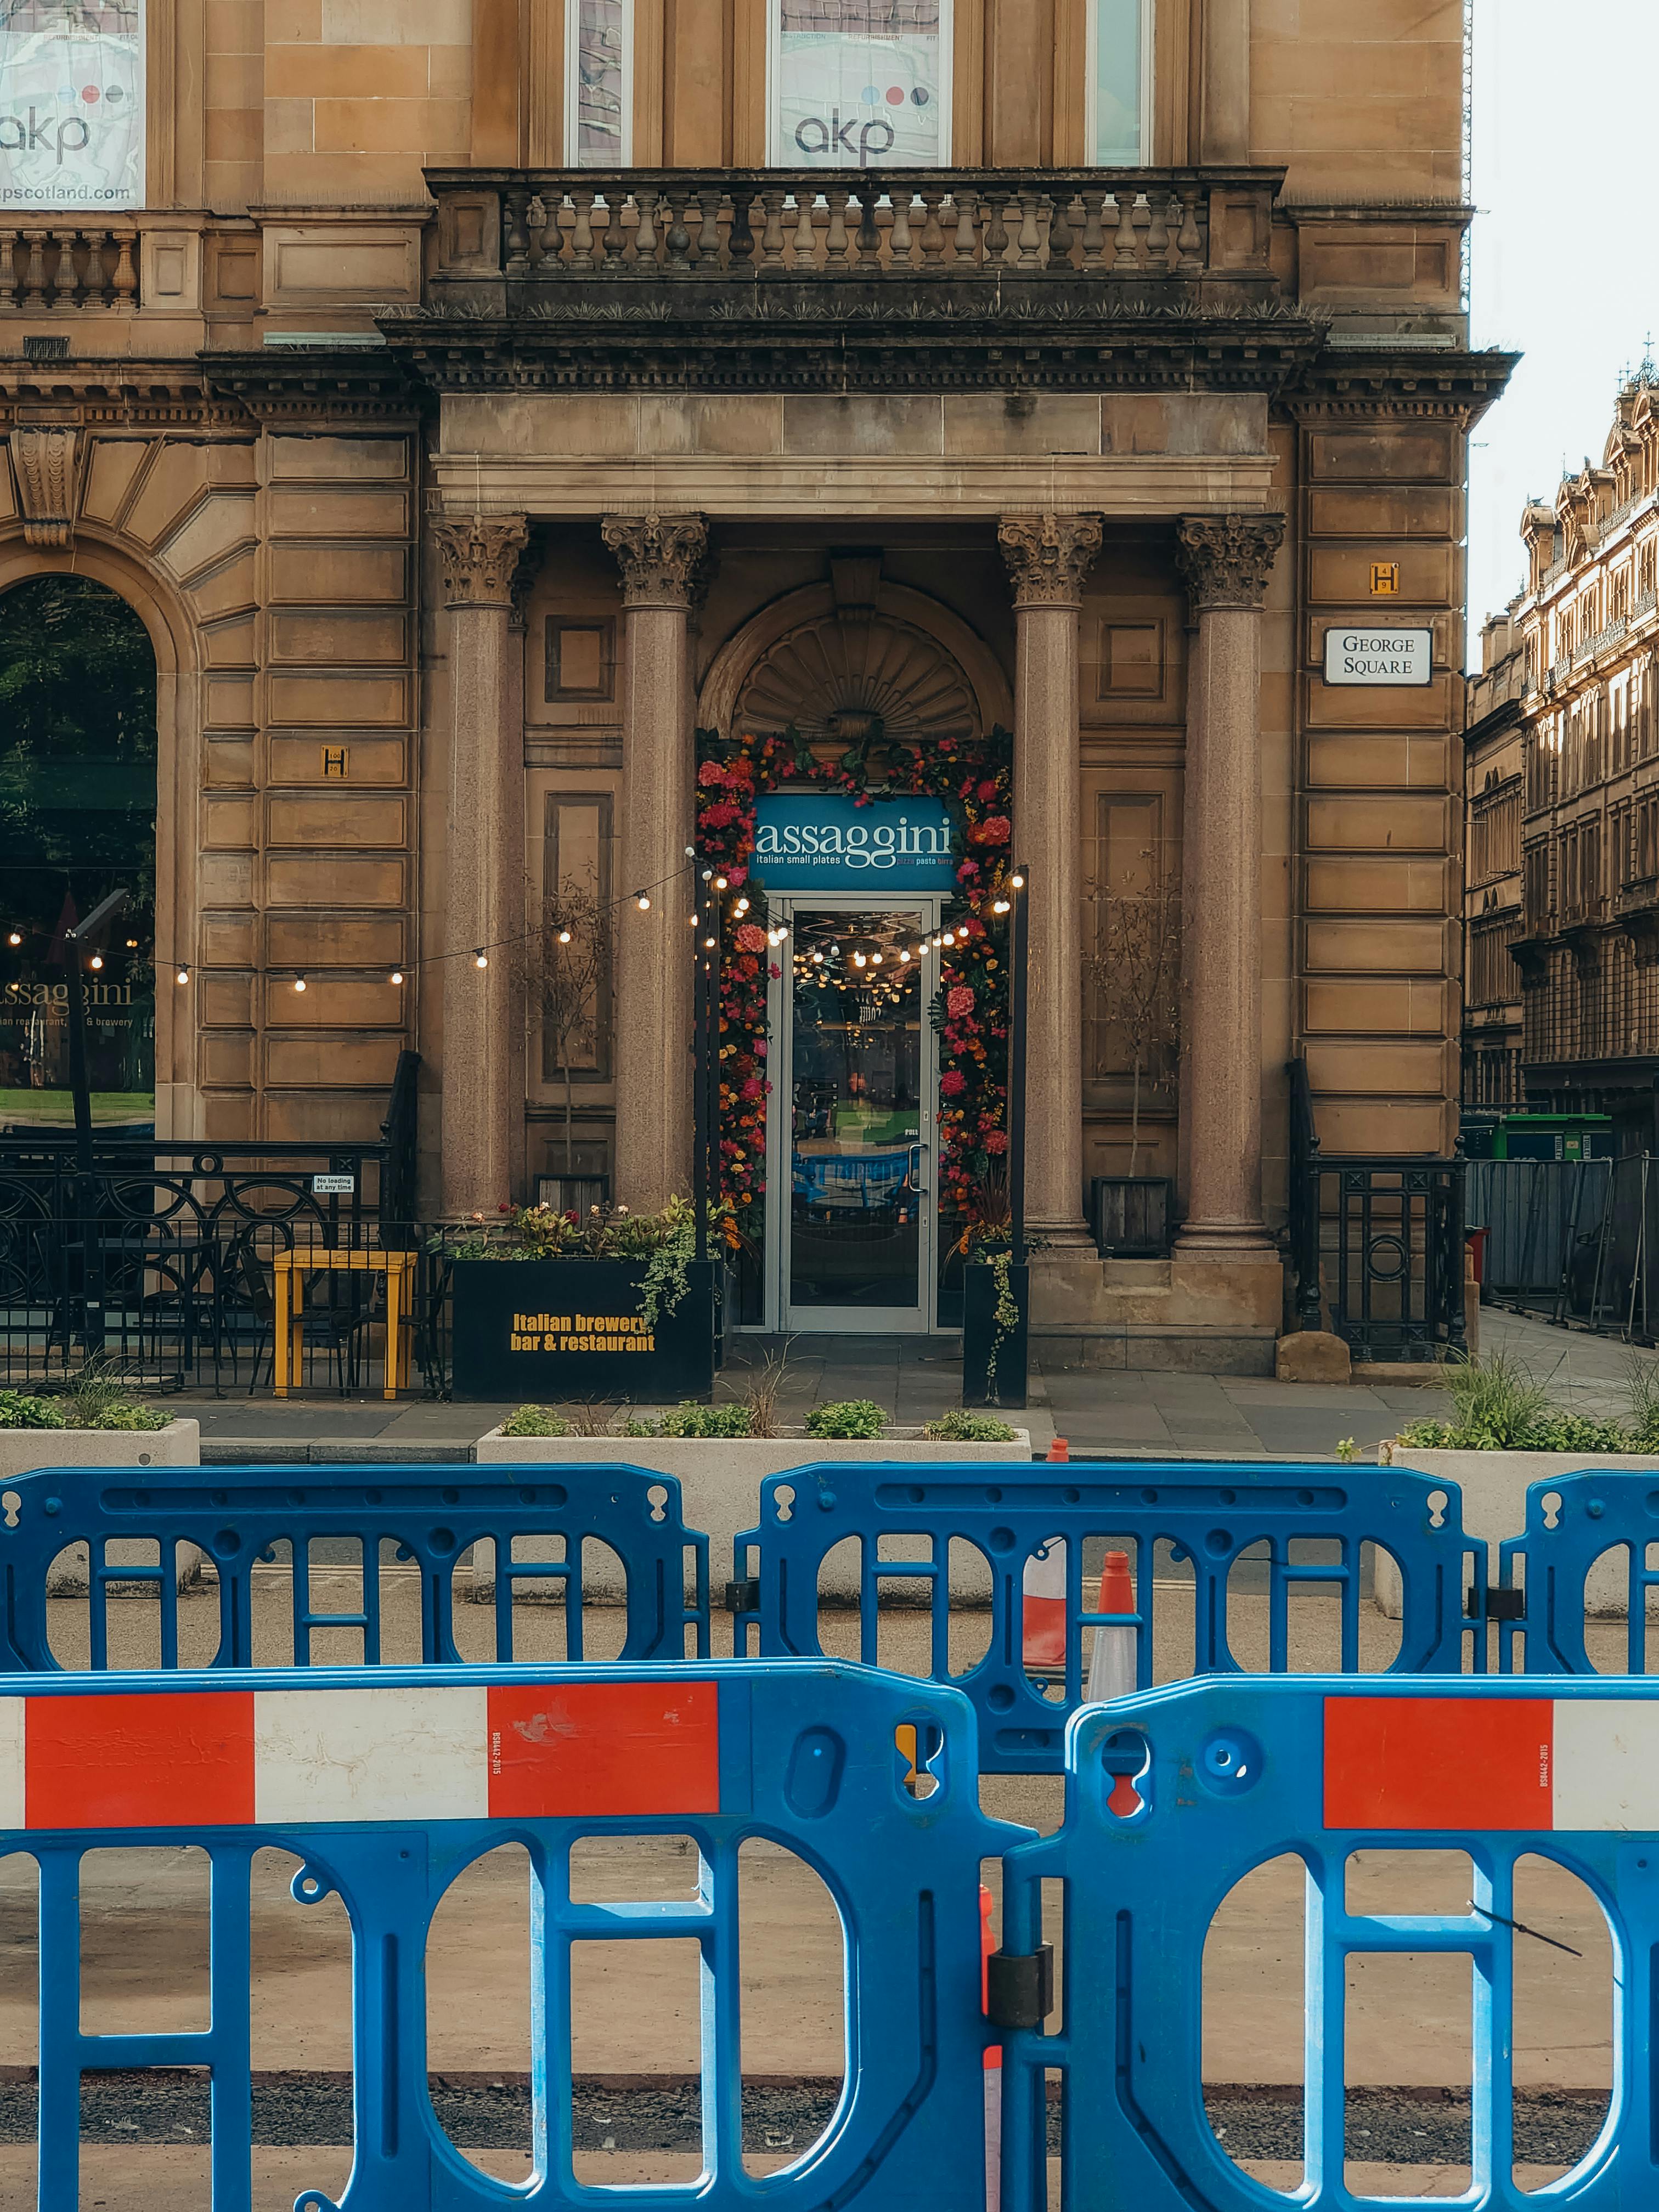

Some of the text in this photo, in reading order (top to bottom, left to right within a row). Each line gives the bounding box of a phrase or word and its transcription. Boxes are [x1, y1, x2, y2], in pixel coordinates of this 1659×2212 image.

[0, 106, 91, 165] akp
[795, 108, 895, 167] akp
[0, 185, 129, 202] pscotland.com
[1374, 566, 1394, 591] H
[1343, 636, 1415, 652] GEORGE
[1344, 657, 1413, 676] SQUARE
[325, 749, 345, 775] H
[756, 817, 951, 868] assaggini
[757, 855, 840, 866] italian small plates
[15, 1018, 67, 1027] resaurant,
[87, 1018, 93, 1026] &
[96, 1018, 133, 1028] brewery
[514, 1314, 571, 1331] Italian
[511, 1334, 655, 1351] bar & restaurant
